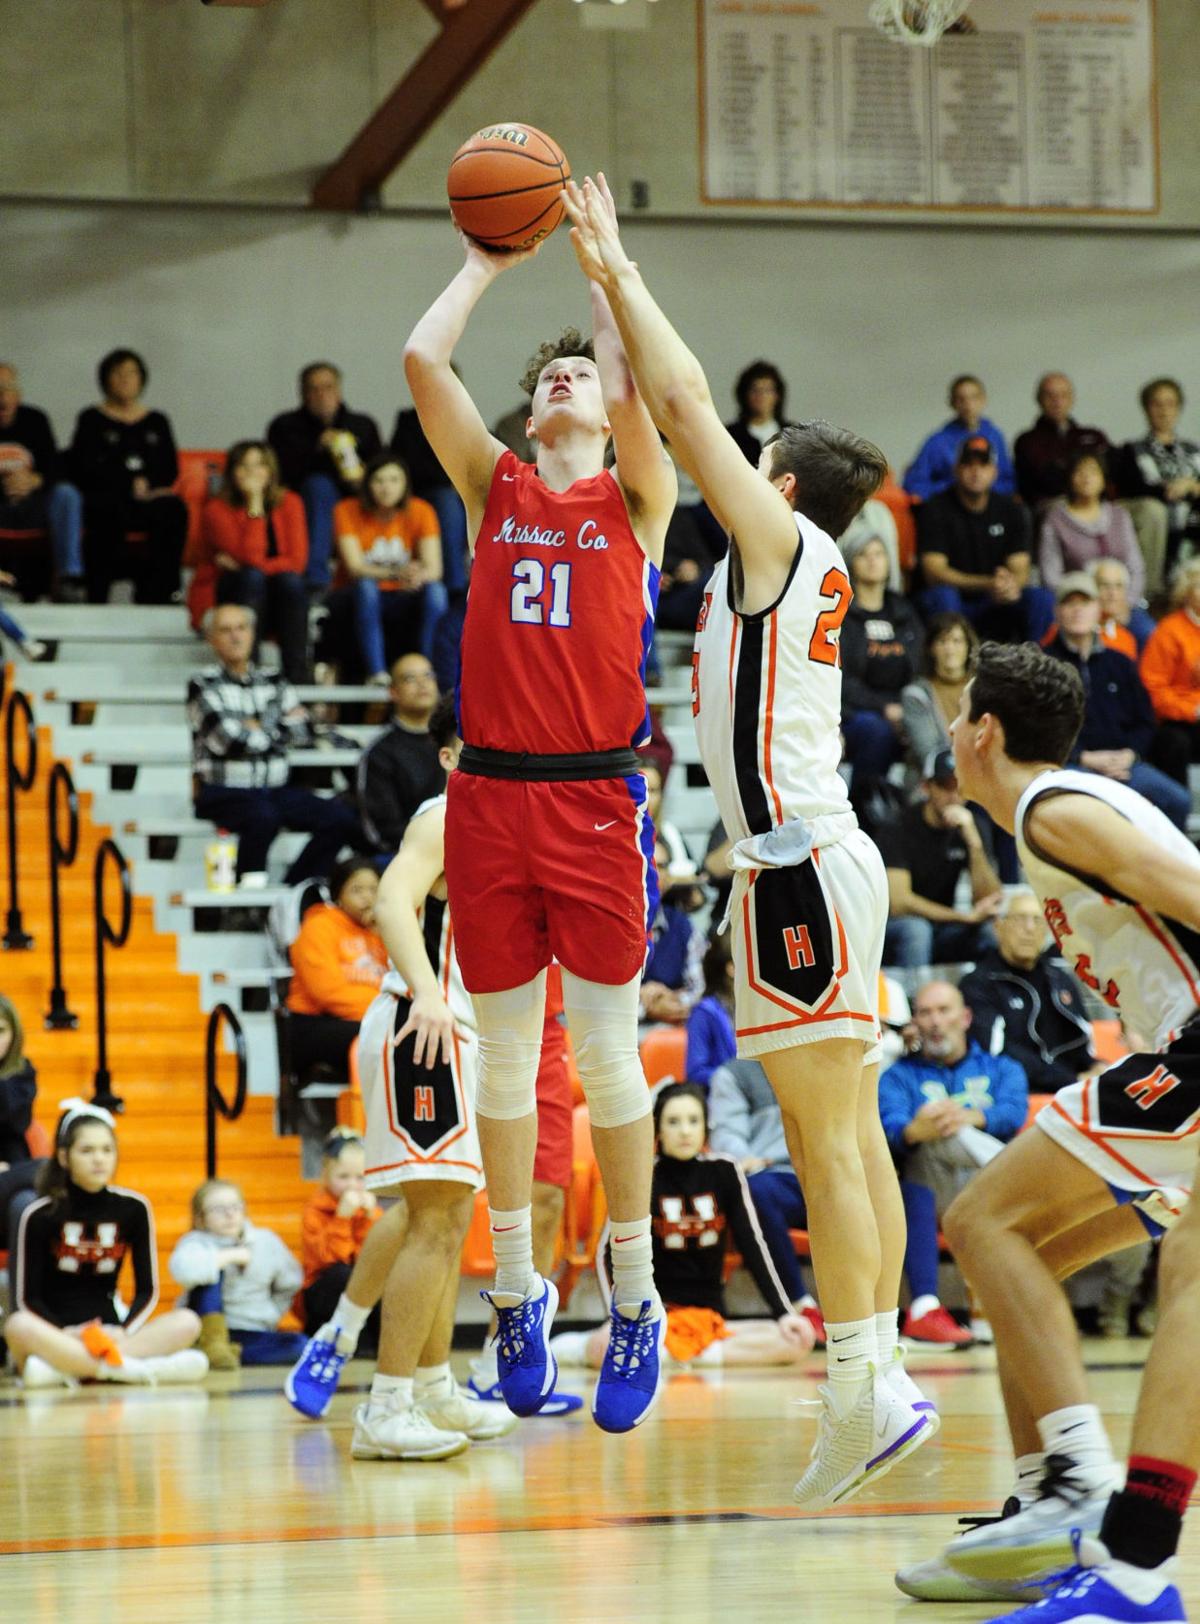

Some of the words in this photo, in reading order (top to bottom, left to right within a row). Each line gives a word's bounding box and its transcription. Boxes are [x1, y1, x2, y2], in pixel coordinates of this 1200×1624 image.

[577, 519, 609, 550] Co
[510, 557, 572, 628] 21
[808, 566, 855, 670] 2
[782, 924, 816, 970] H
[413, 1086, 435, 1121] H
[1124, 1063, 1181, 1110] H
